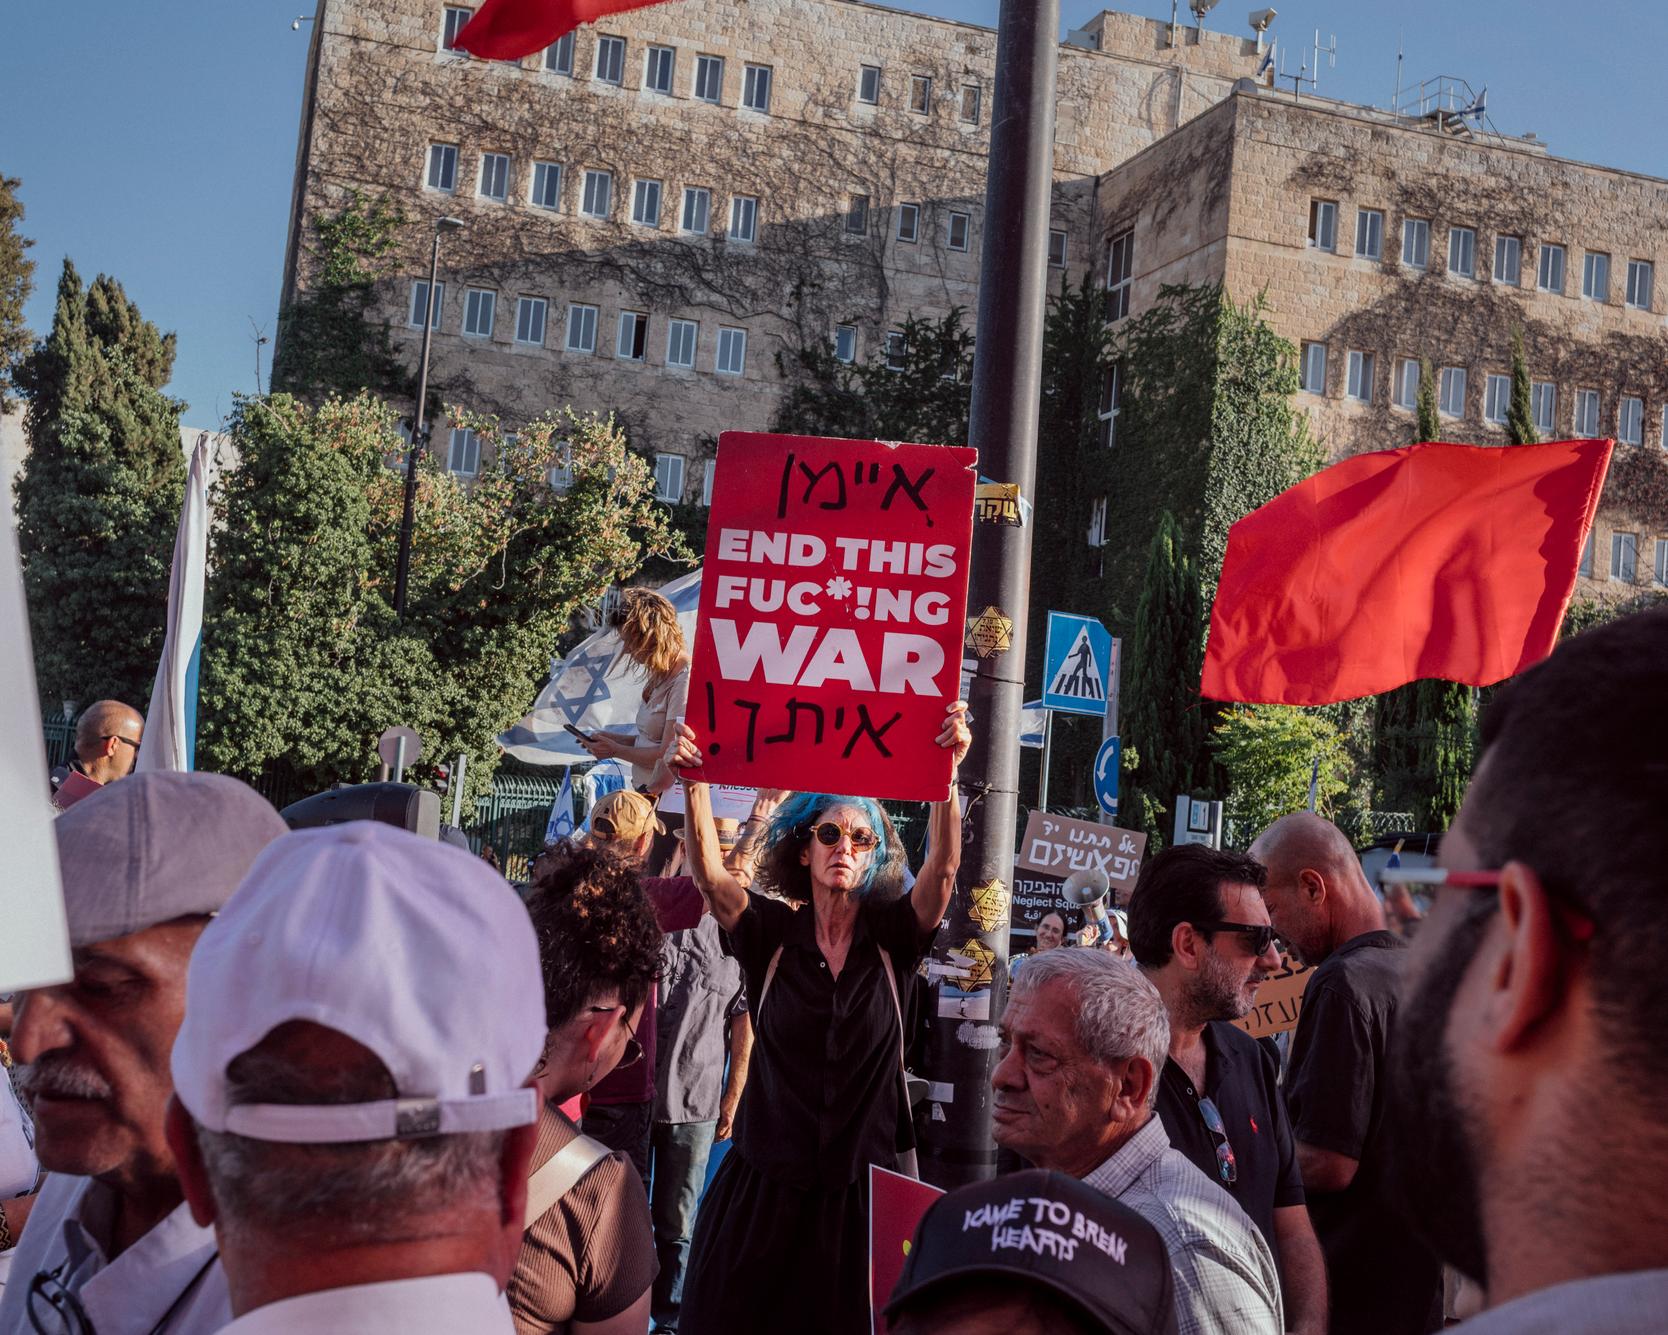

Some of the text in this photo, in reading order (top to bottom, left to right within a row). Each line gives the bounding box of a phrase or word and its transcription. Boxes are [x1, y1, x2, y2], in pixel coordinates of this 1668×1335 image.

[777, 453, 935, 527] איימן
[717, 528, 957, 578] END THIS
[709, 617, 943, 697] WAR
[706, 681, 902, 763] איתך!
[1069, 828, 1111, 849] תתנו
[1118, 834, 1137, 854] אל
[1012, 895, 1082, 911] Neglect Squa
[991, 1224, 1079, 1262] HEARTS
[1028, 1197, 1071, 1226] TO
[1071, 1211, 1129, 1266] BREAK
